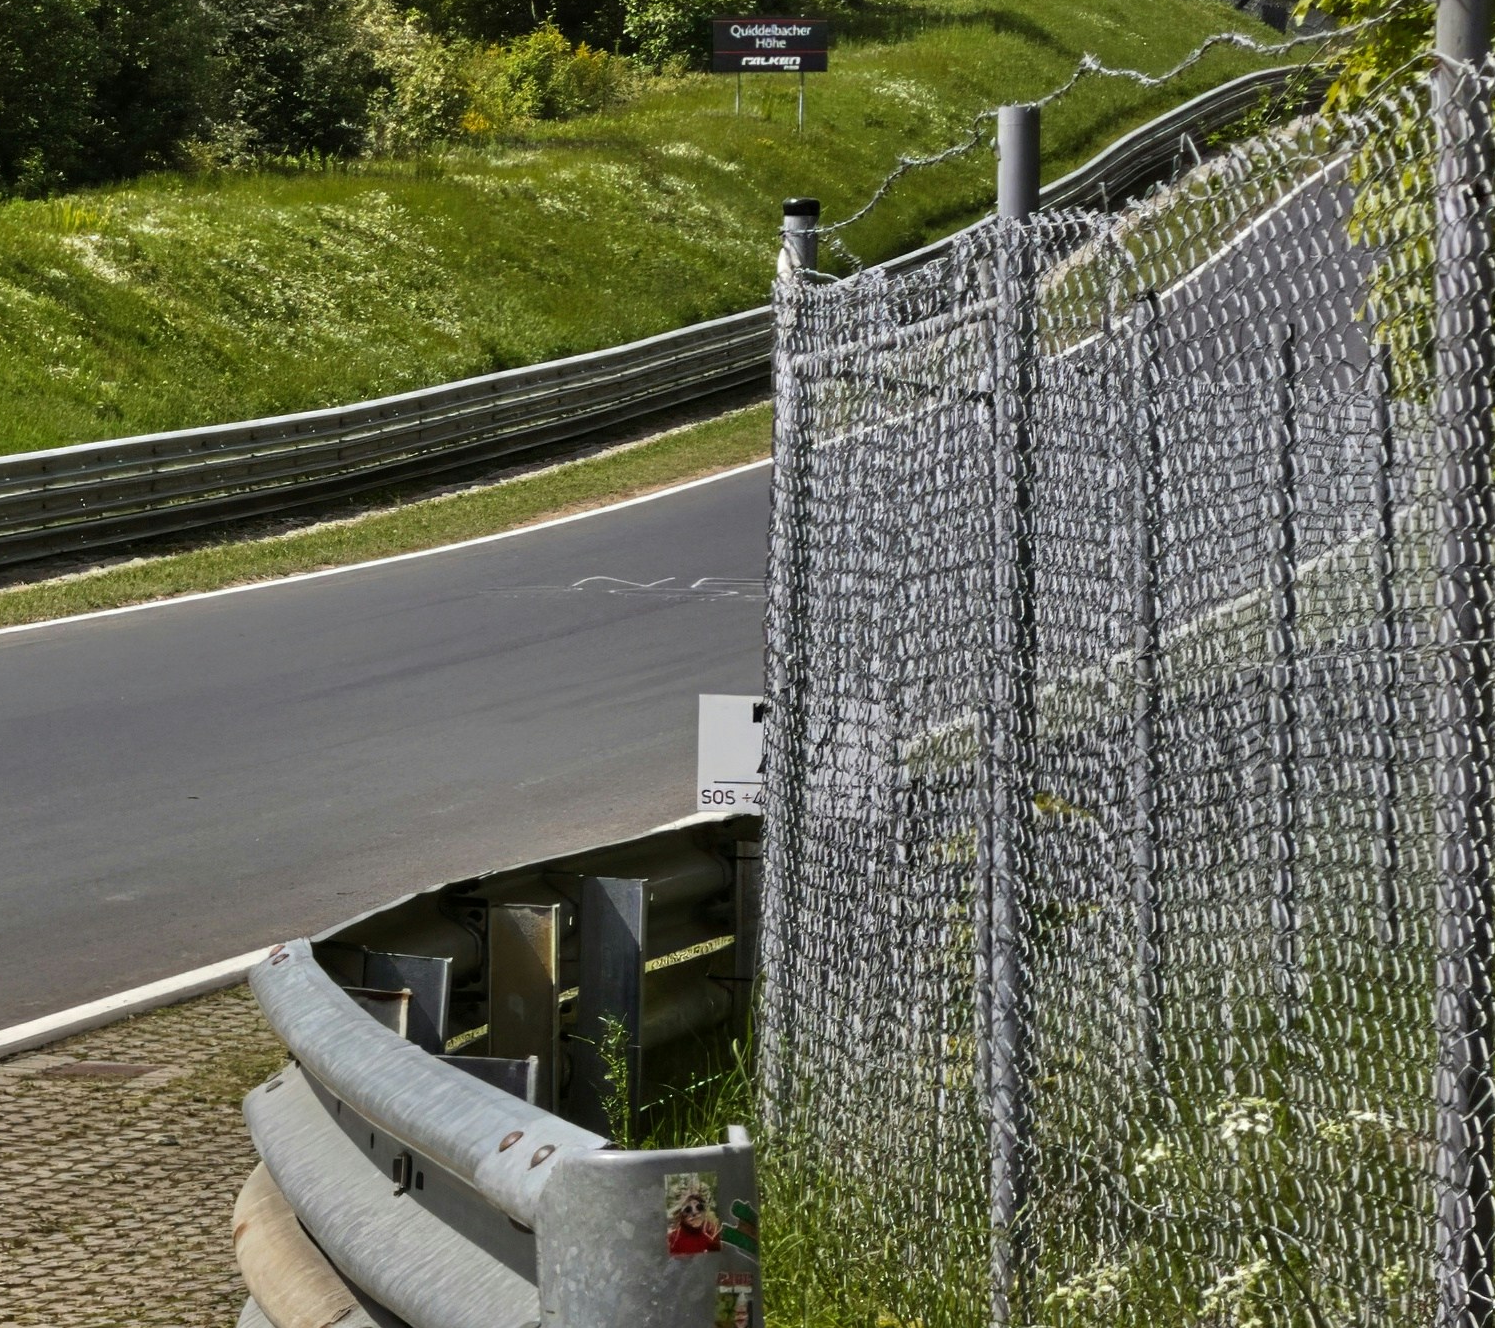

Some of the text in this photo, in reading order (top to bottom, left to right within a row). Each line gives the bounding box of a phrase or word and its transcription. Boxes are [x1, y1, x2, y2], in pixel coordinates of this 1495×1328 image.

[730, 24, 812, 38] Quiddelbacher
[755, 37, 787, 49] Höhe
[701, 789, 736, 805] SOS
